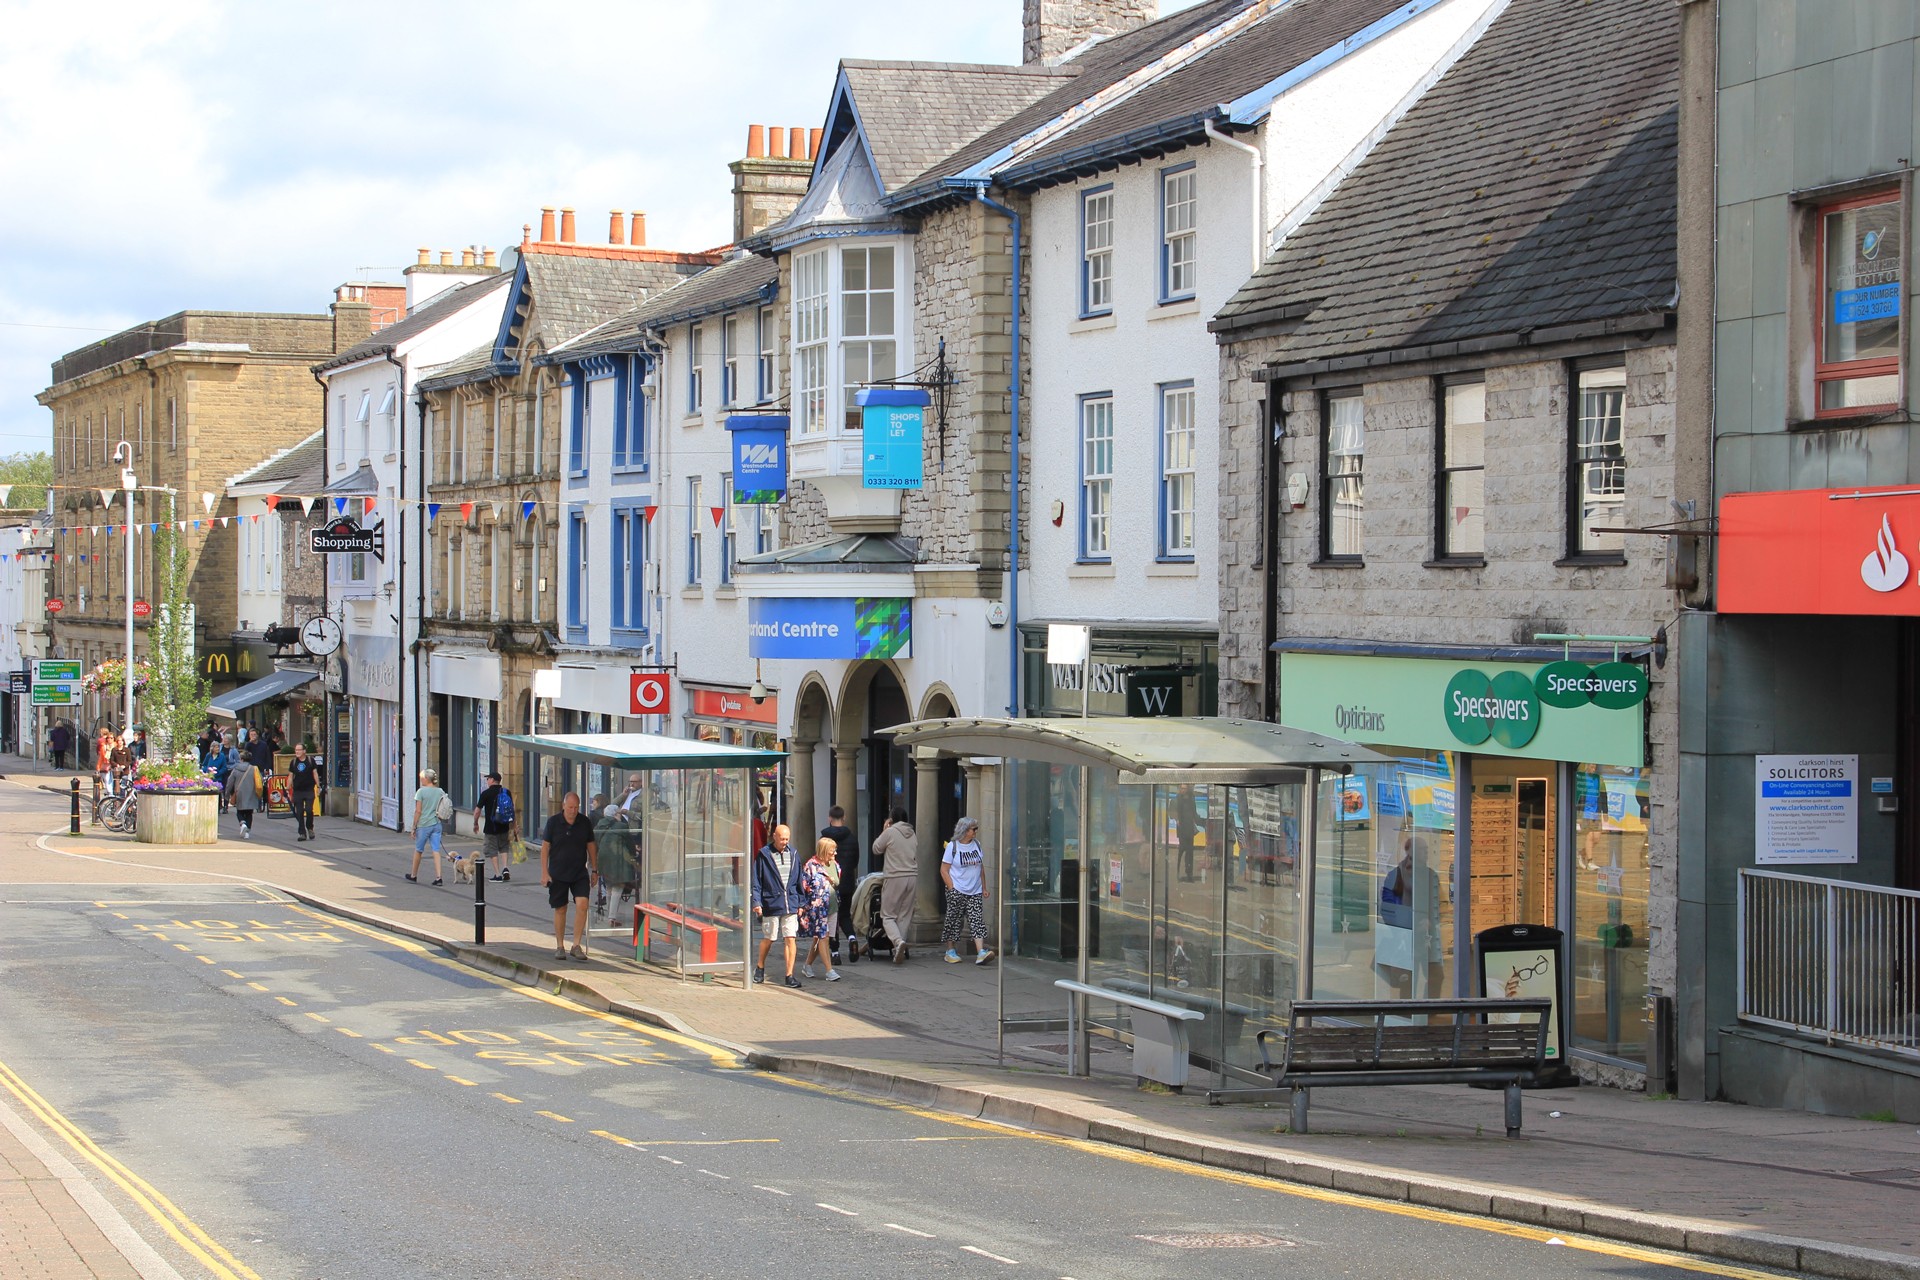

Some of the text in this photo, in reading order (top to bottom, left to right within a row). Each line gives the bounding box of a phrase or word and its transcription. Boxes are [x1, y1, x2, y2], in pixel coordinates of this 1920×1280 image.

[1870, 287, 1899, 300] NUMBER
[1871, 301, 1892, 314] 39760
[890, 413, 920, 421] SHOPS
[313, 536, 371, 549] Shopping
[782, 621, 839, 637] Centre
[1547, 674, 1637, 695] Specsavers
[727, 700, 741, 710] vodafone
[1138, 687, 1172, 713] W
[1453, 690, 1529, 722] Specsavers
[1335, 704, 1385, 734] Opticians
[1770, 768, 1844, 778] SOLICITORS
[154, 919, 334, 930] STOP
[194, 932, 344, 943] BUS
[394, 1030, 656, 1046] STOP
